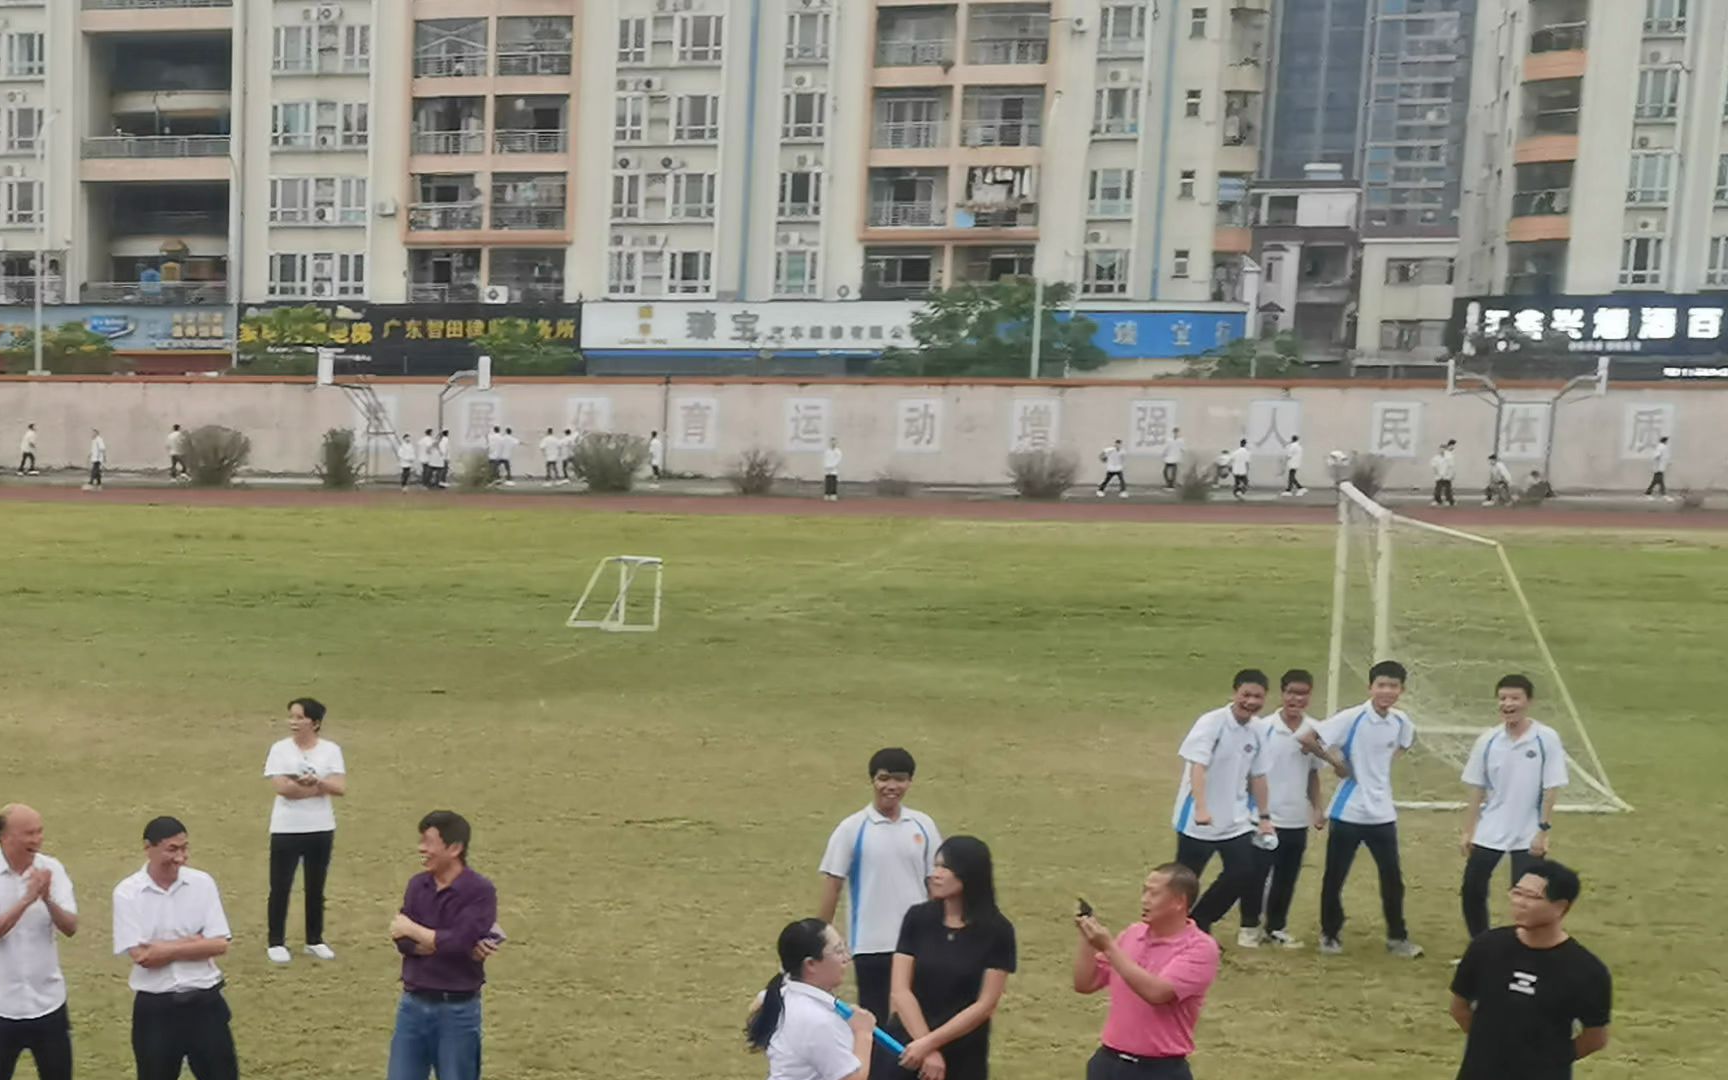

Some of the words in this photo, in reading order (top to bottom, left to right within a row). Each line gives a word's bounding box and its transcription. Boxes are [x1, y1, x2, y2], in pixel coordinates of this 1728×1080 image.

[382, 318, 576, 340] 广东智田律务所
